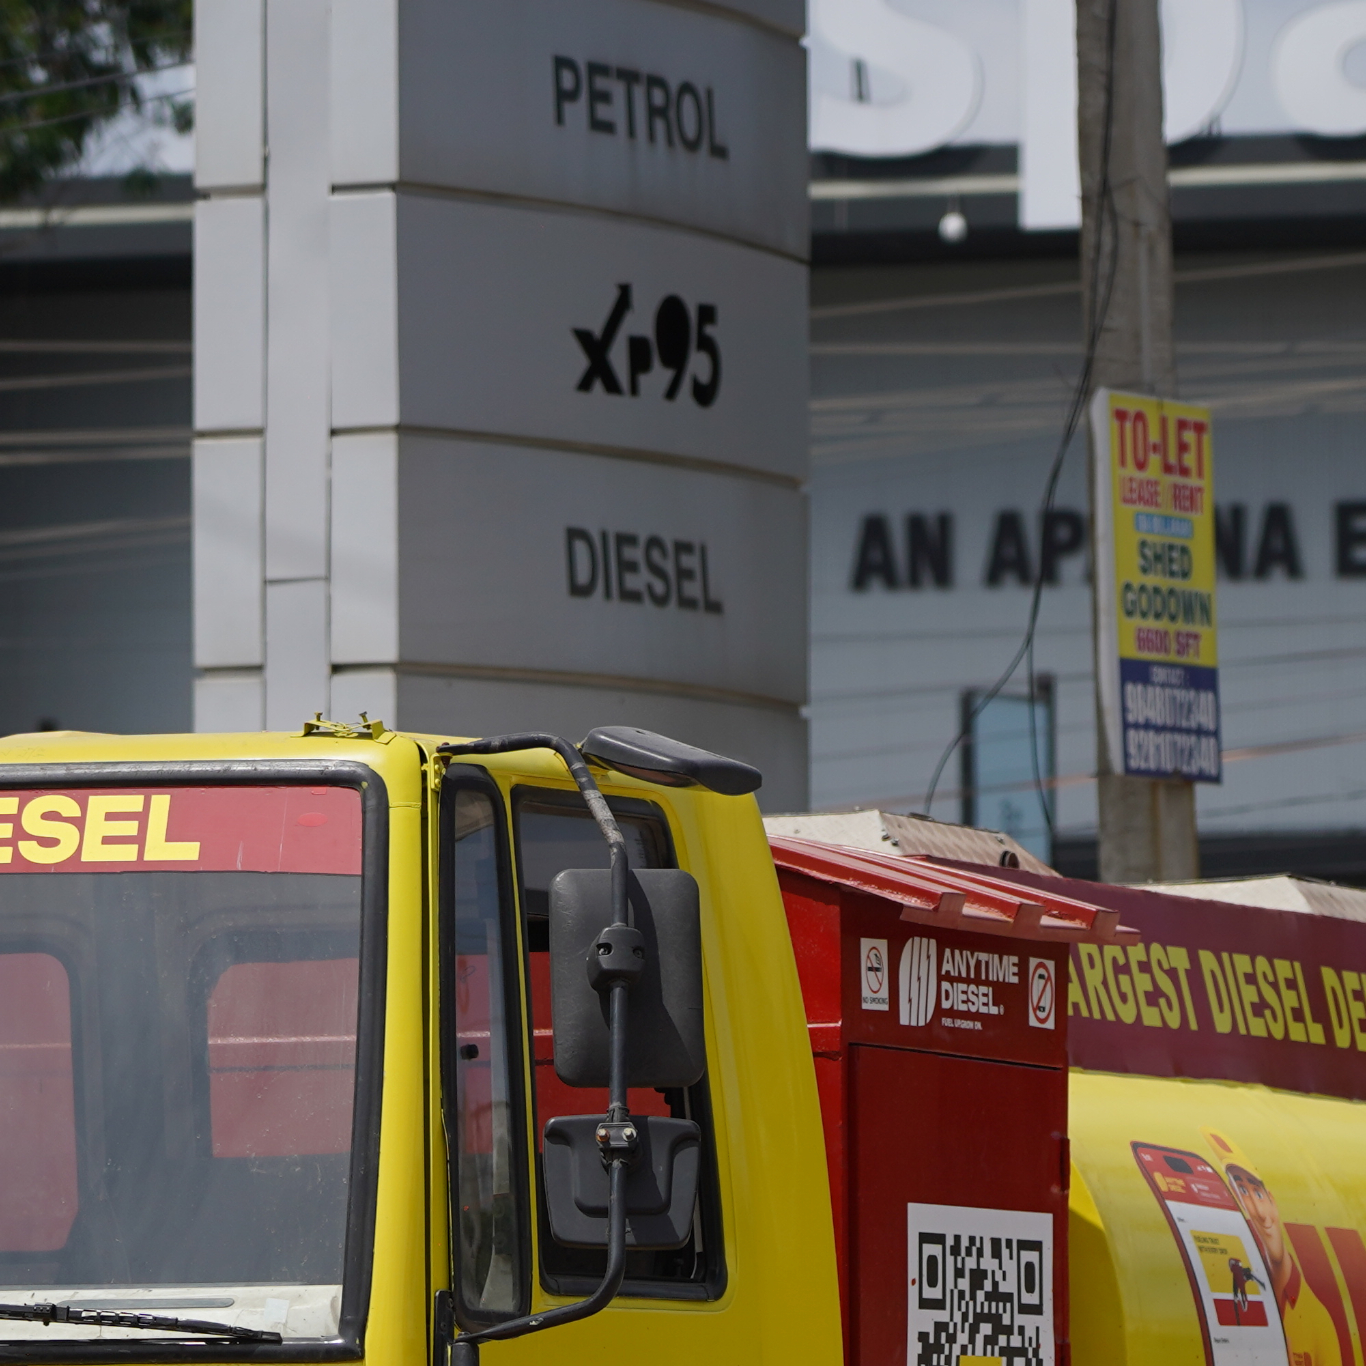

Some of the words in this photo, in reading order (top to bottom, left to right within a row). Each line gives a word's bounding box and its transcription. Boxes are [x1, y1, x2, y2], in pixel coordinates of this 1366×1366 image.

[552, 53, 728, 160] PETROL
[1113, 409, 1208, 480] TO-LET
[1120, 476, 1161, 509] LEASE
[1173, 483, 1204, 515] RENT
[852, 512, 953, 590] AN
[987, 500, 1303, 588] APNA
[1139, 538, 1193, 581] SHED
[1122, 581, 1212, 628] GODOWN
[1175, 630, 1202, 660] SFT
[941, 948, 1019, 984] ANYTIME
[869, 996, 888, 1005] SMOKING
[1068, 943, 1198, 1031] ARGEST
[1199, 950, 1326, 1045] DIESEL
